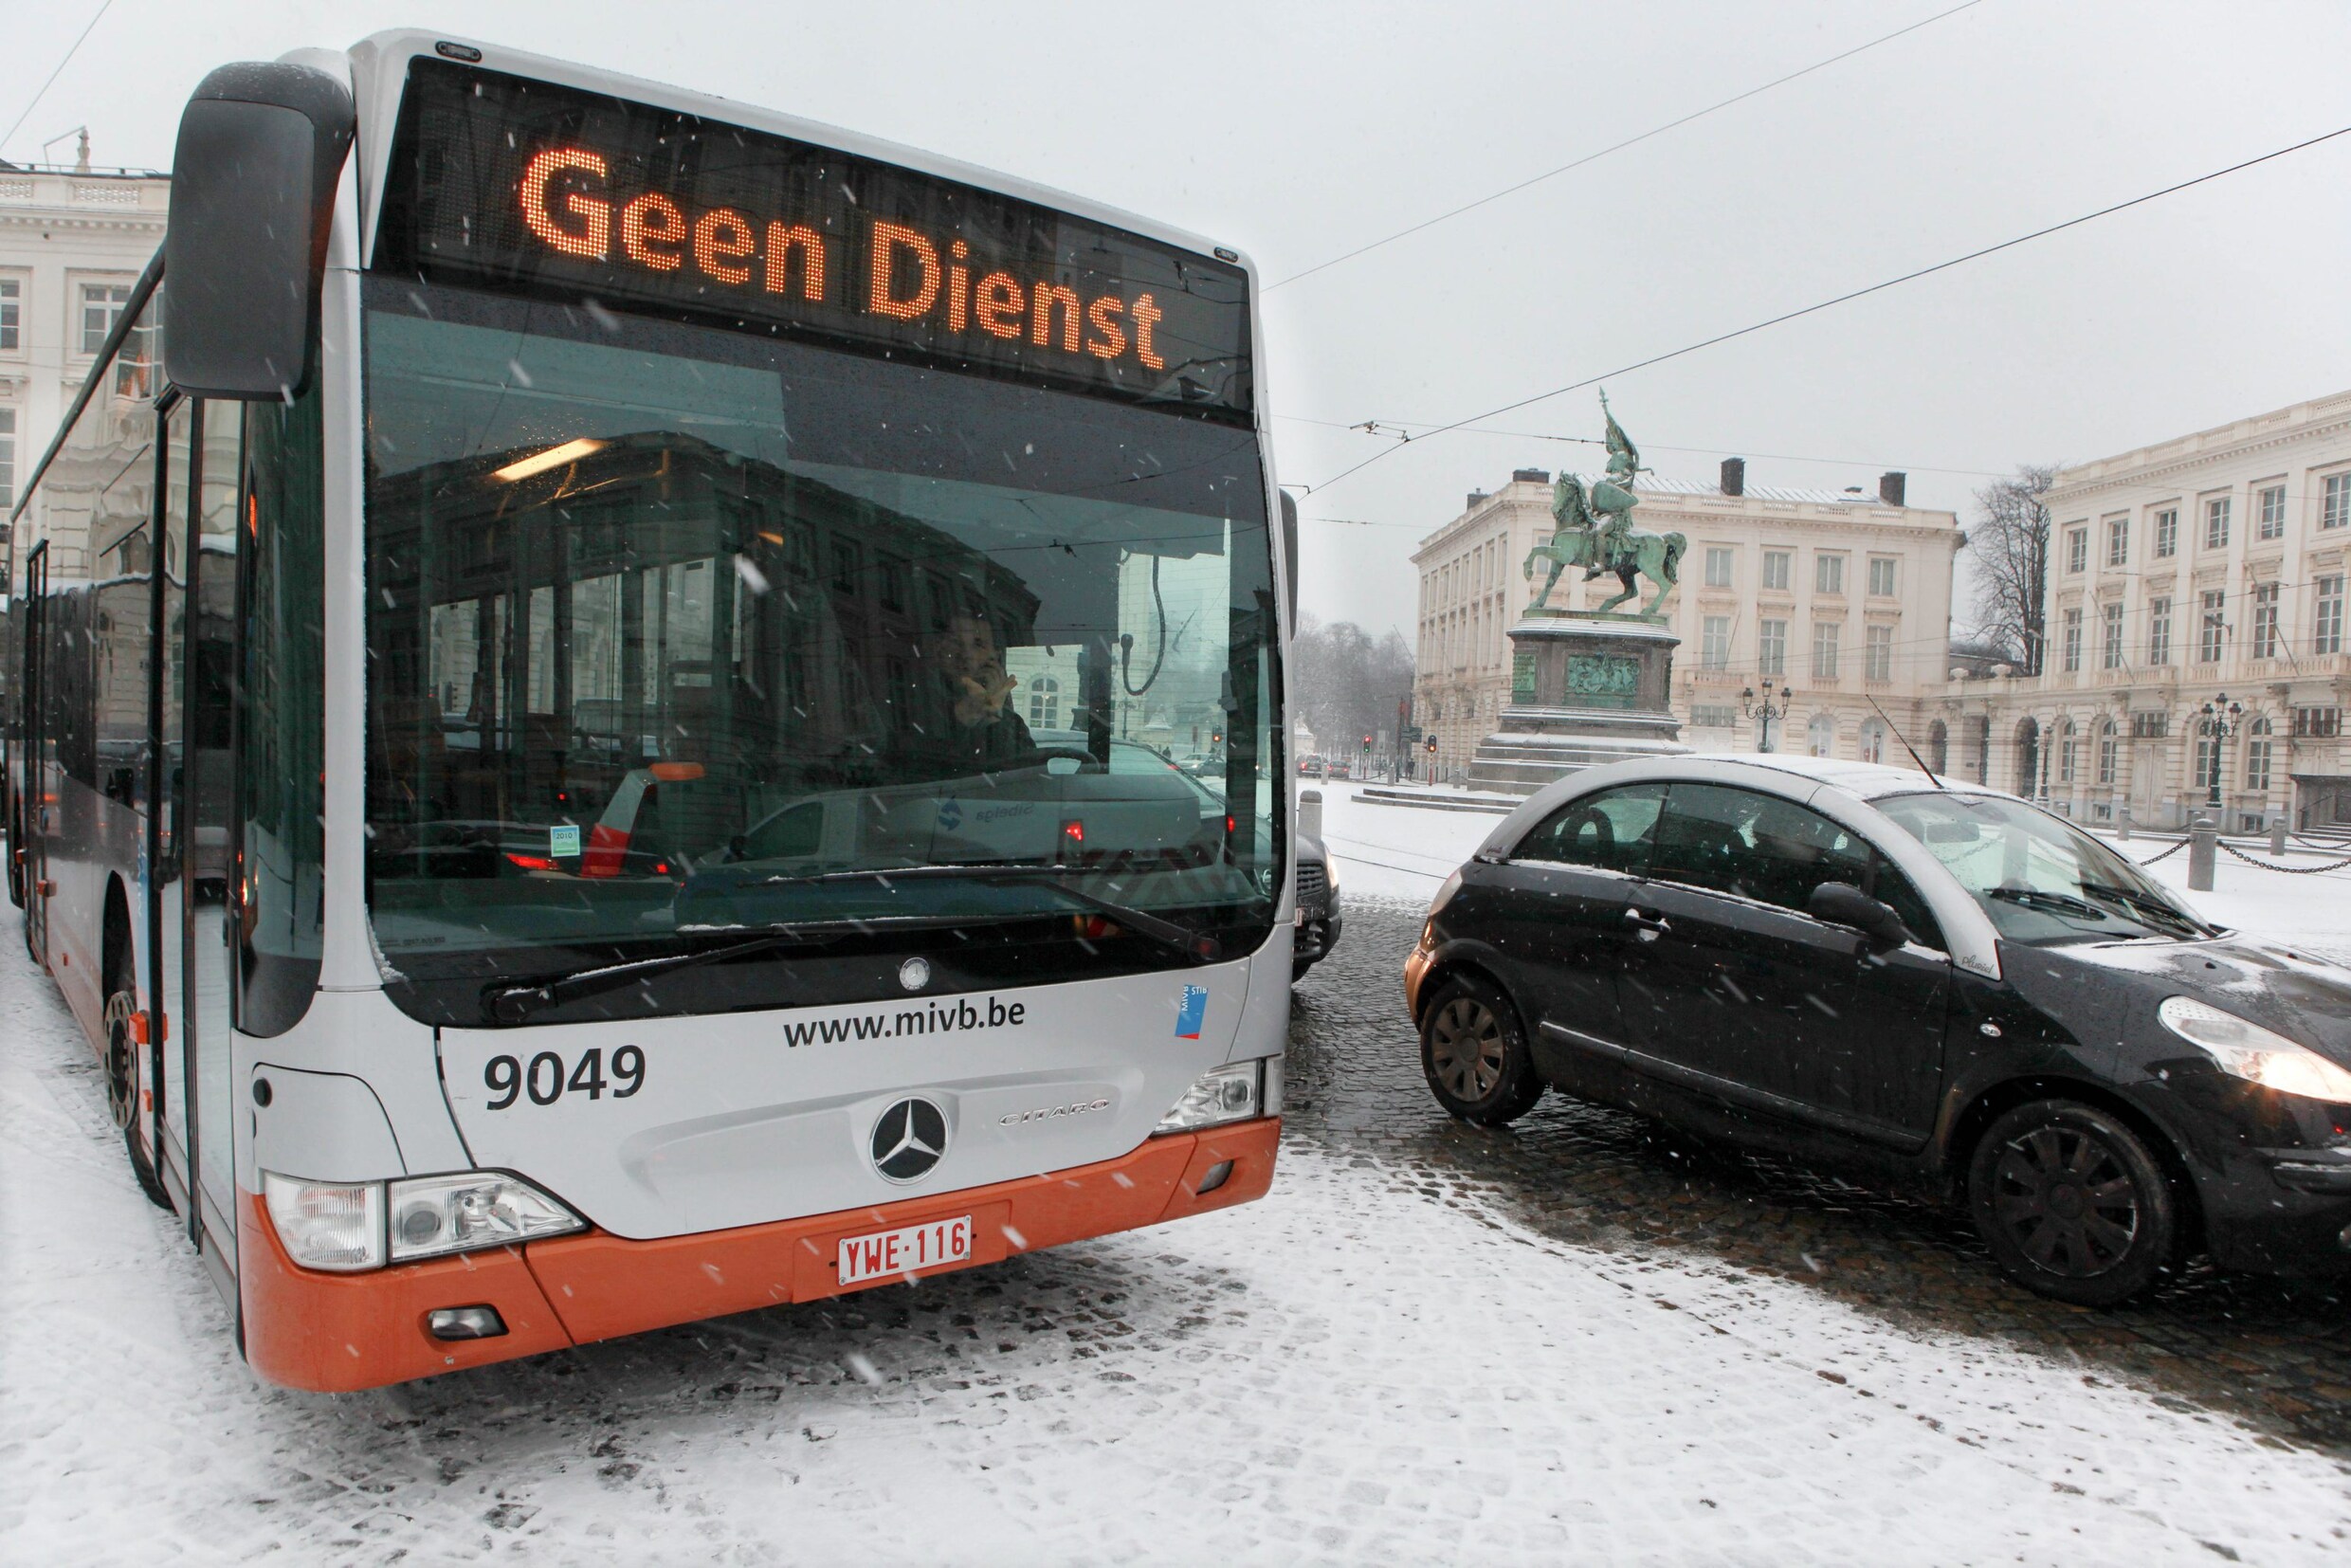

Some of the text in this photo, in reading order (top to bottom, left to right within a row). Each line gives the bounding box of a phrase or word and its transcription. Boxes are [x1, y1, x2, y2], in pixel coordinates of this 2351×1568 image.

[520, 148, 1164, 370] Geen Dienst
[783, 996, 1026, 1048] www.mivb.be
[484, 1045, 646, 1110] 9049
[998, 1099, 1110, 1126] CITARO
